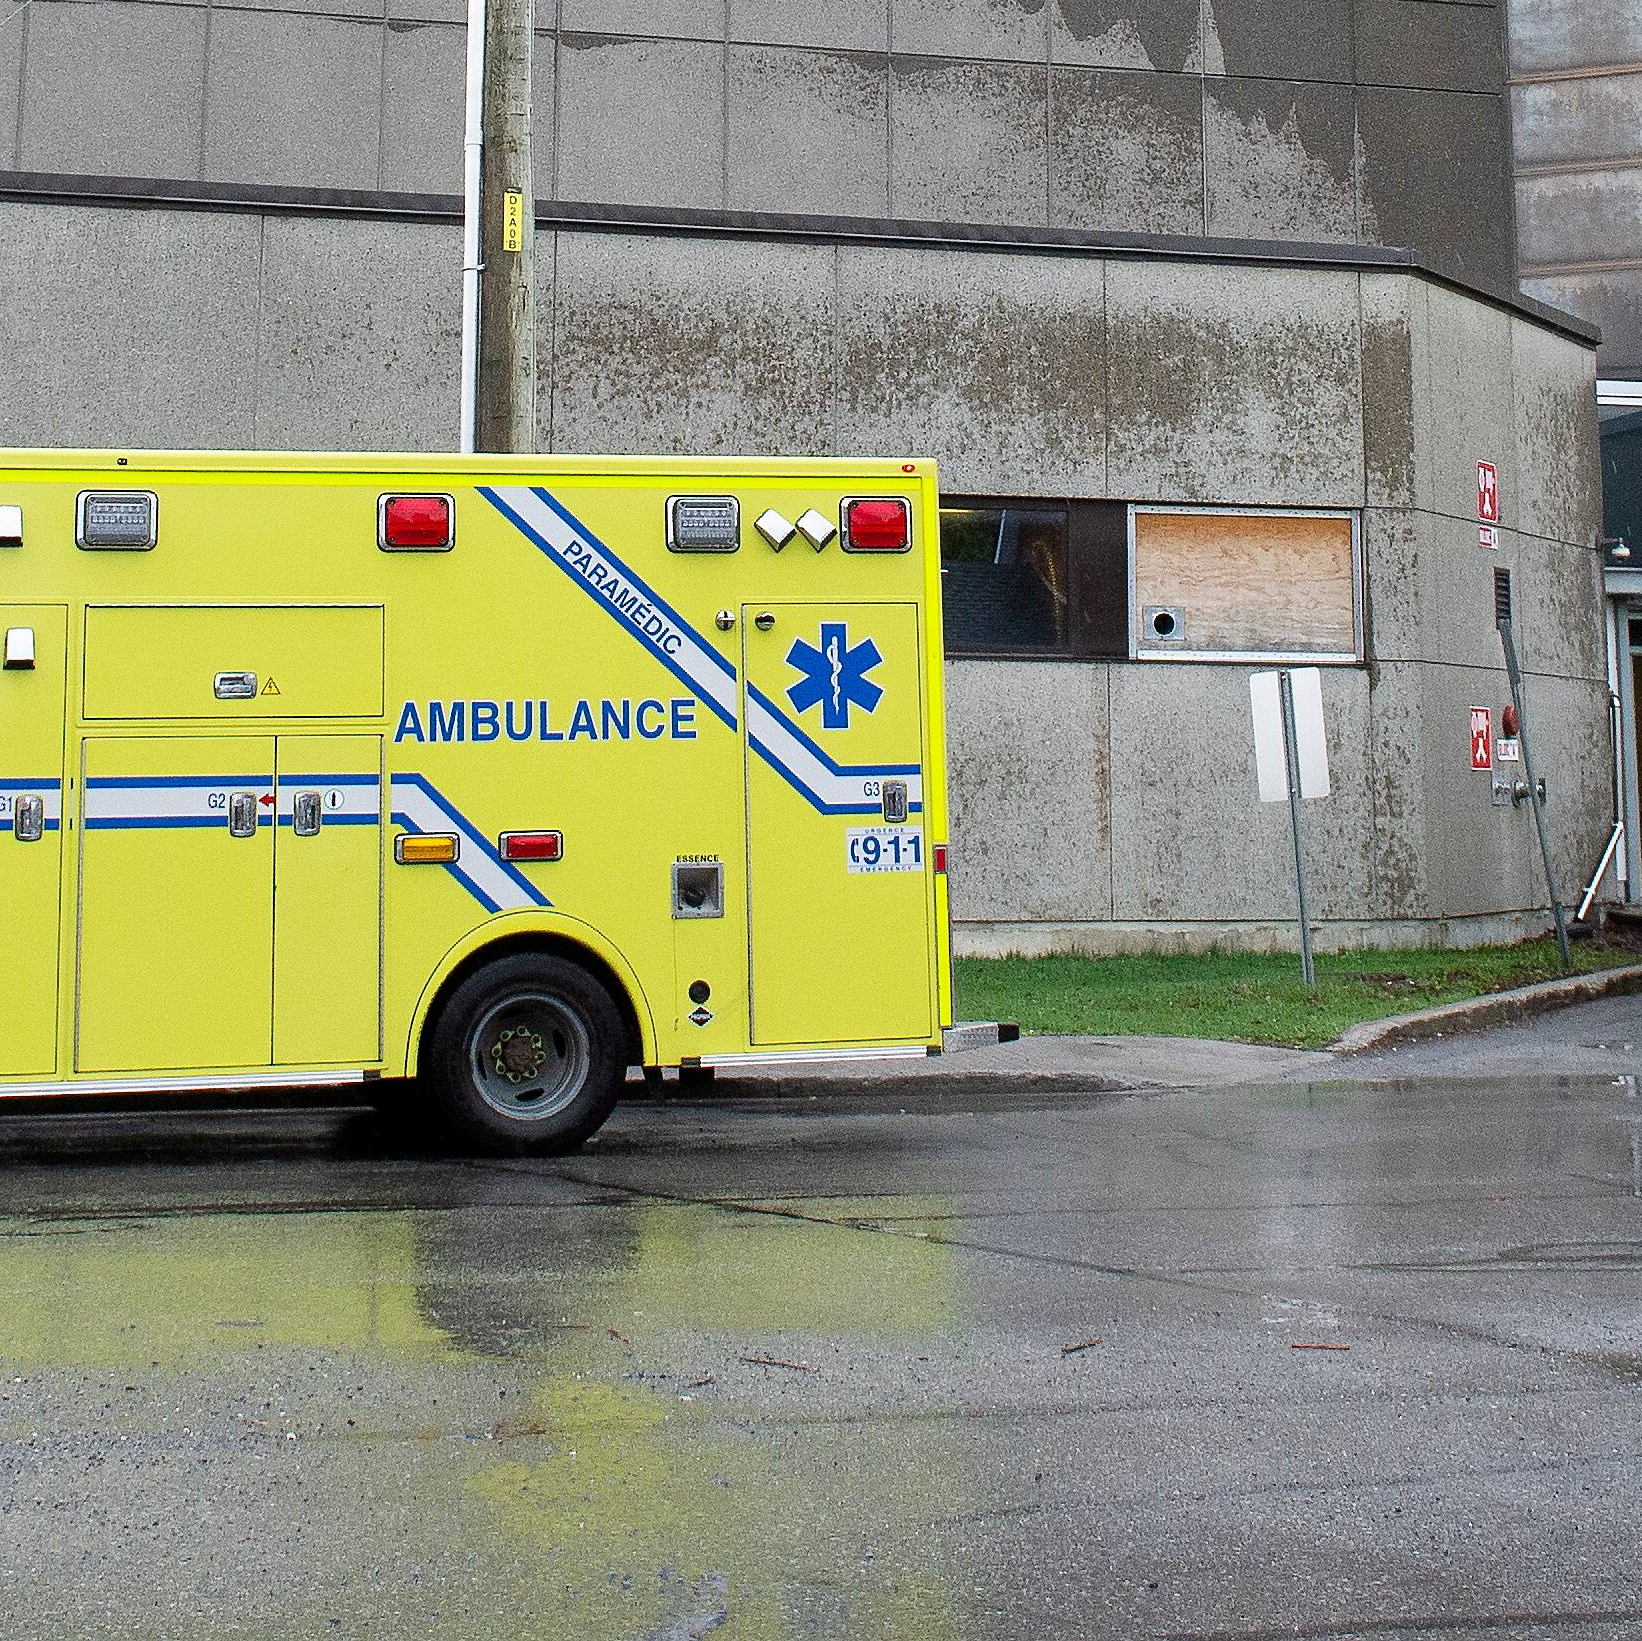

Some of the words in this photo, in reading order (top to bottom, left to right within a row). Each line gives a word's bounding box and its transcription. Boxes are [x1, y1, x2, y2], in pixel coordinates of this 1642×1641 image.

[562, 539, 682, 655] PARAMÉDIC
[393, 699, 698, 743] AMBULANCE
[208, 793, 226, 808] G2
[863, 782, 880, 797] G3
[676, 854, 720, 863] ESSENCE
[862, 835, 921, 865] 9-1-1
